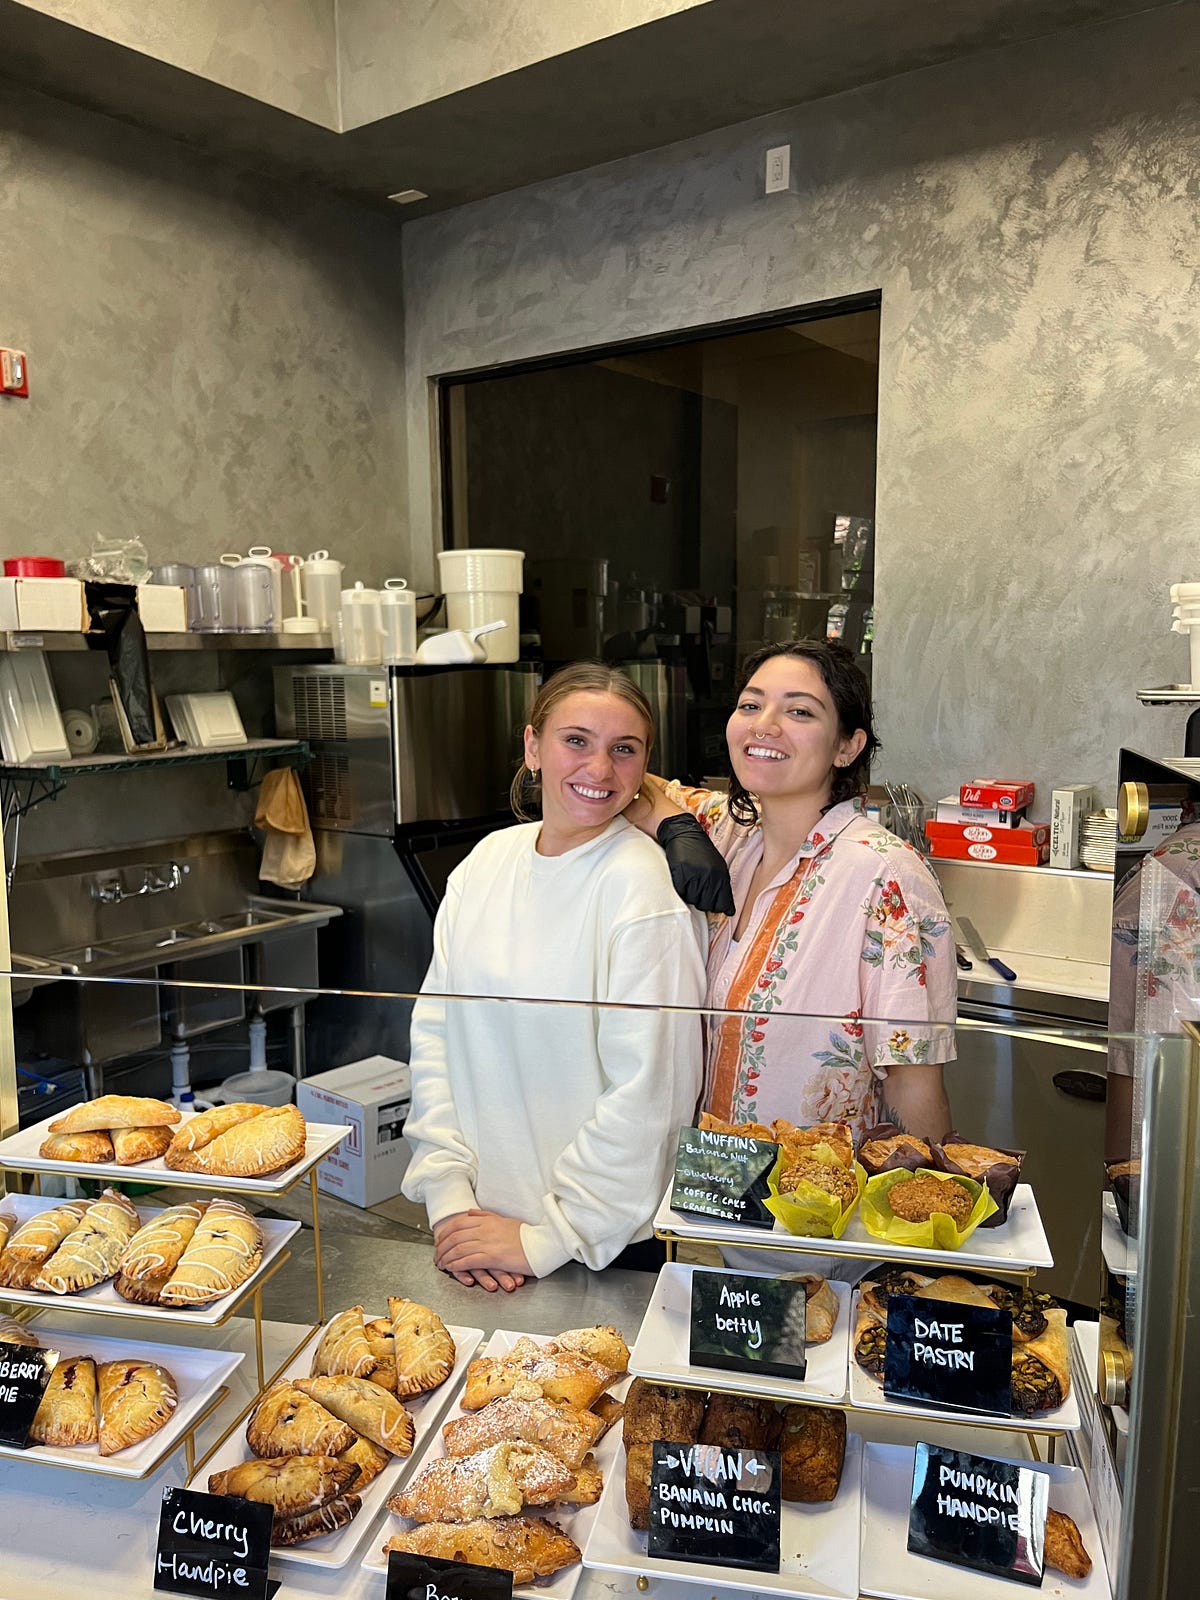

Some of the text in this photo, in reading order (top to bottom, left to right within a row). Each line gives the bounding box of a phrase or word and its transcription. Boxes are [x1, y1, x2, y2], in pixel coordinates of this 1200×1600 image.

[963, 789, 981, 802] Deli
[685, 1143, 748, 1163] Banana Nut
[700, 1130, 758, 1153] MUFFINS
[682, 1201, 742, 1221] CRANBERRY
[683, 1186, 747, 1209] COFFEE CAKE
[719, 1284, 761, 1309] Apple
[715, 1313, 762, 1349] betty
[914, 1317, 965, 1343] DATE
[913, 1342, 975, 1371] PASTRY
[0, 1361, 43, 1380] BERRY
[679, 1447, 743, 1480] VEGAN
[659, 1483, 728, 1510] BANANA
[939, 1464, 1022, 1506] PUMPKIN
[660, 1507, 734, 1535] PUMPKIN
[936, 1492, 1023, 1532] HANDPIE
[172, 1510, 249, 1558] Cherry
[157, 1552, 250, 1590] Handpie
